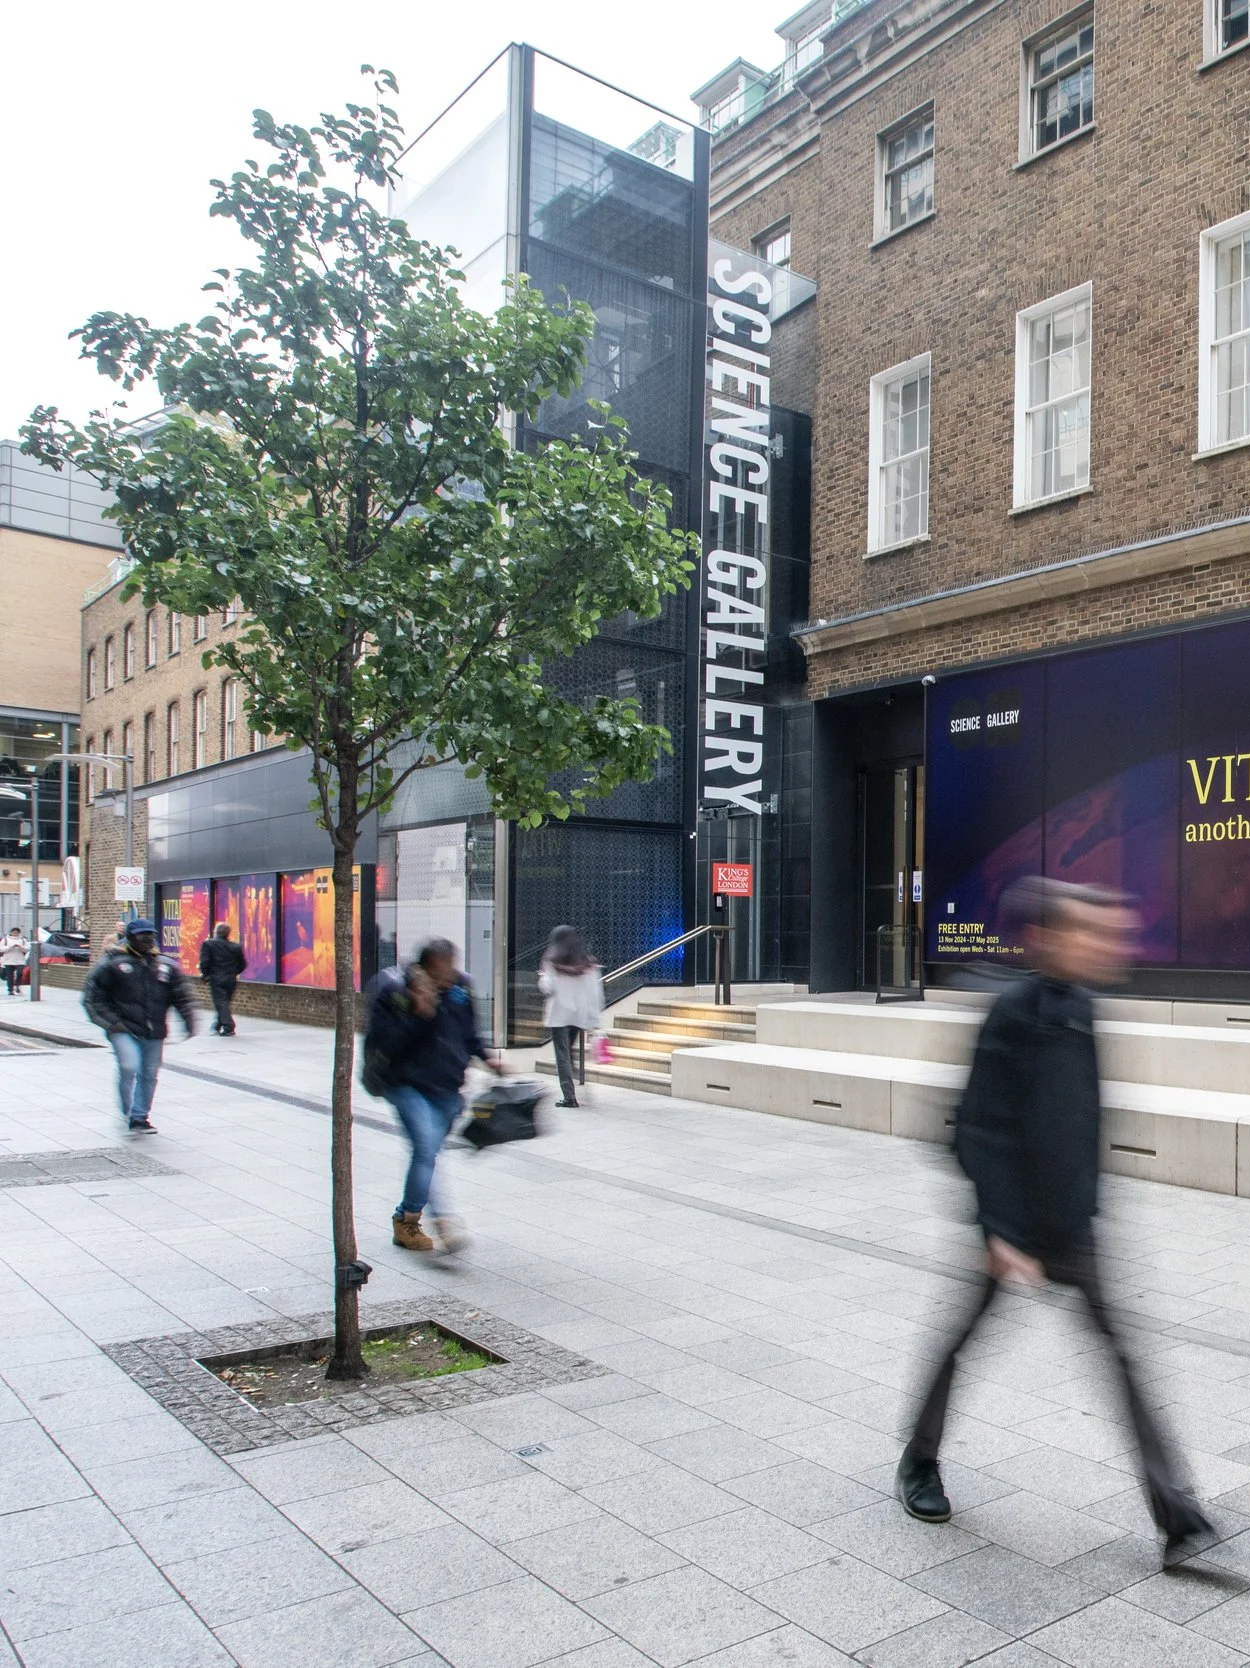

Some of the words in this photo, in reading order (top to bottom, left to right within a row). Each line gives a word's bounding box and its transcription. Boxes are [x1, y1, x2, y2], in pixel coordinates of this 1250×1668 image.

[708, 257, 772, 526] SCIENCE
[704, 548, 767, 818] GALLERY
[950, 715, 981, 733] SCIENCE
[986, 709, 1020, 728] GALLERY
[938, 923, 957, 934] FREE
[959, 923, 985, 934] ENTRY
[976, 936, 986, 944] May
[986, 936, 1000, 944] 2025
